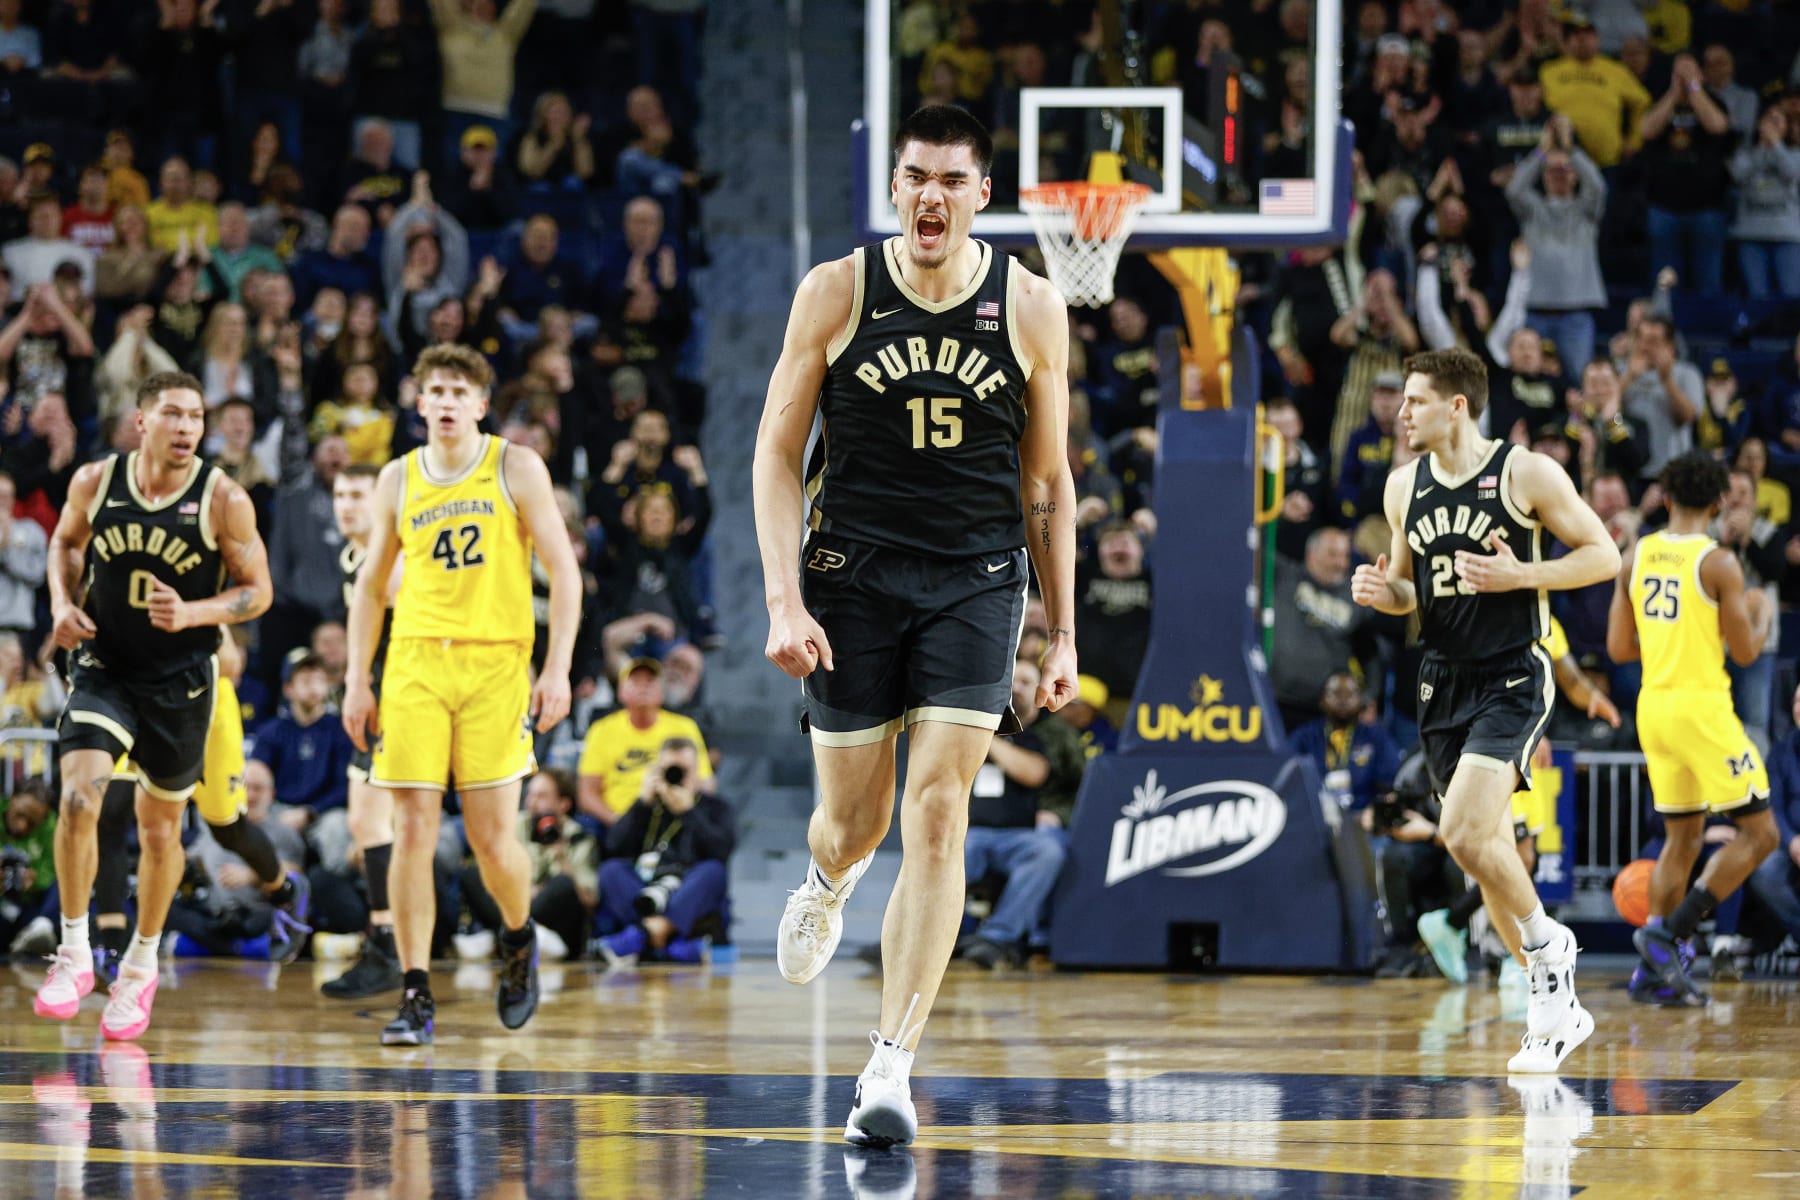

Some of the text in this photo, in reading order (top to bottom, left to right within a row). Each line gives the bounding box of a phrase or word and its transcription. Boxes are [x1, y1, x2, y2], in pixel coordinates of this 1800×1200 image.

[855, 336, 1007, 401] PURDUE
[906, 397, 963, 449] 15
[411, 499, 495, 531] MICHIGAN
[1031, 502, 1056, 515] M4G
[93, 523, 202, 576] PURDUE
[432, 524, 485, 570] 42
[1431, 554, 1476, 597] 2
[1642, 576, 1680, 621] 25
[1137, 702, 1262, 743] UMCU
[1726, 751, 1755, 777] M
[1104, 796, 1267, 888] LIBMAN
